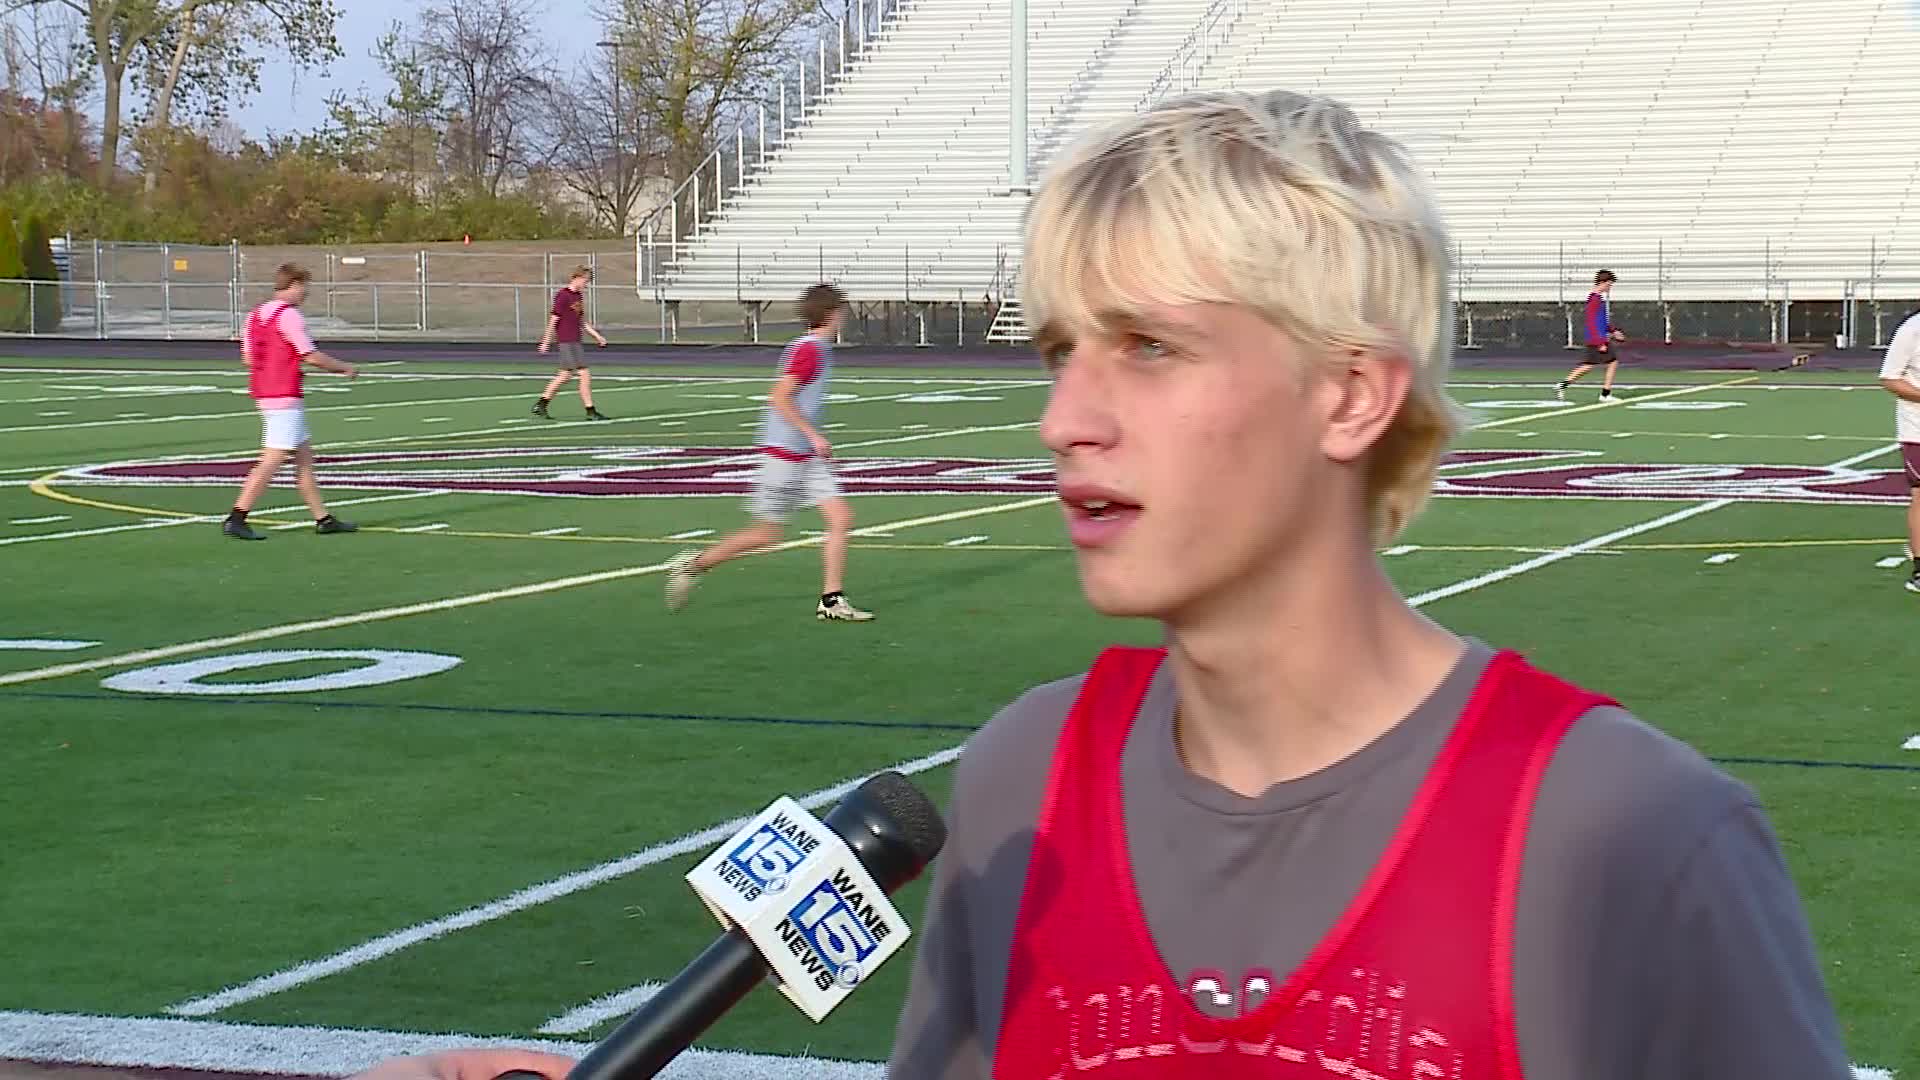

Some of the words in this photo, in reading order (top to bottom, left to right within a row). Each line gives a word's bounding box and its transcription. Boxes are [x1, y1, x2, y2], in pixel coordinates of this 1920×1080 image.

[730, 827, 803, 888] 15
[771, 811, 820, 854] WANE
[713, 859, 763, 902] NEWS
[833, 867, 892, 942] WANE
[774, 917, 835, 992] NEWS
[795, 886, 876, 967] 15
